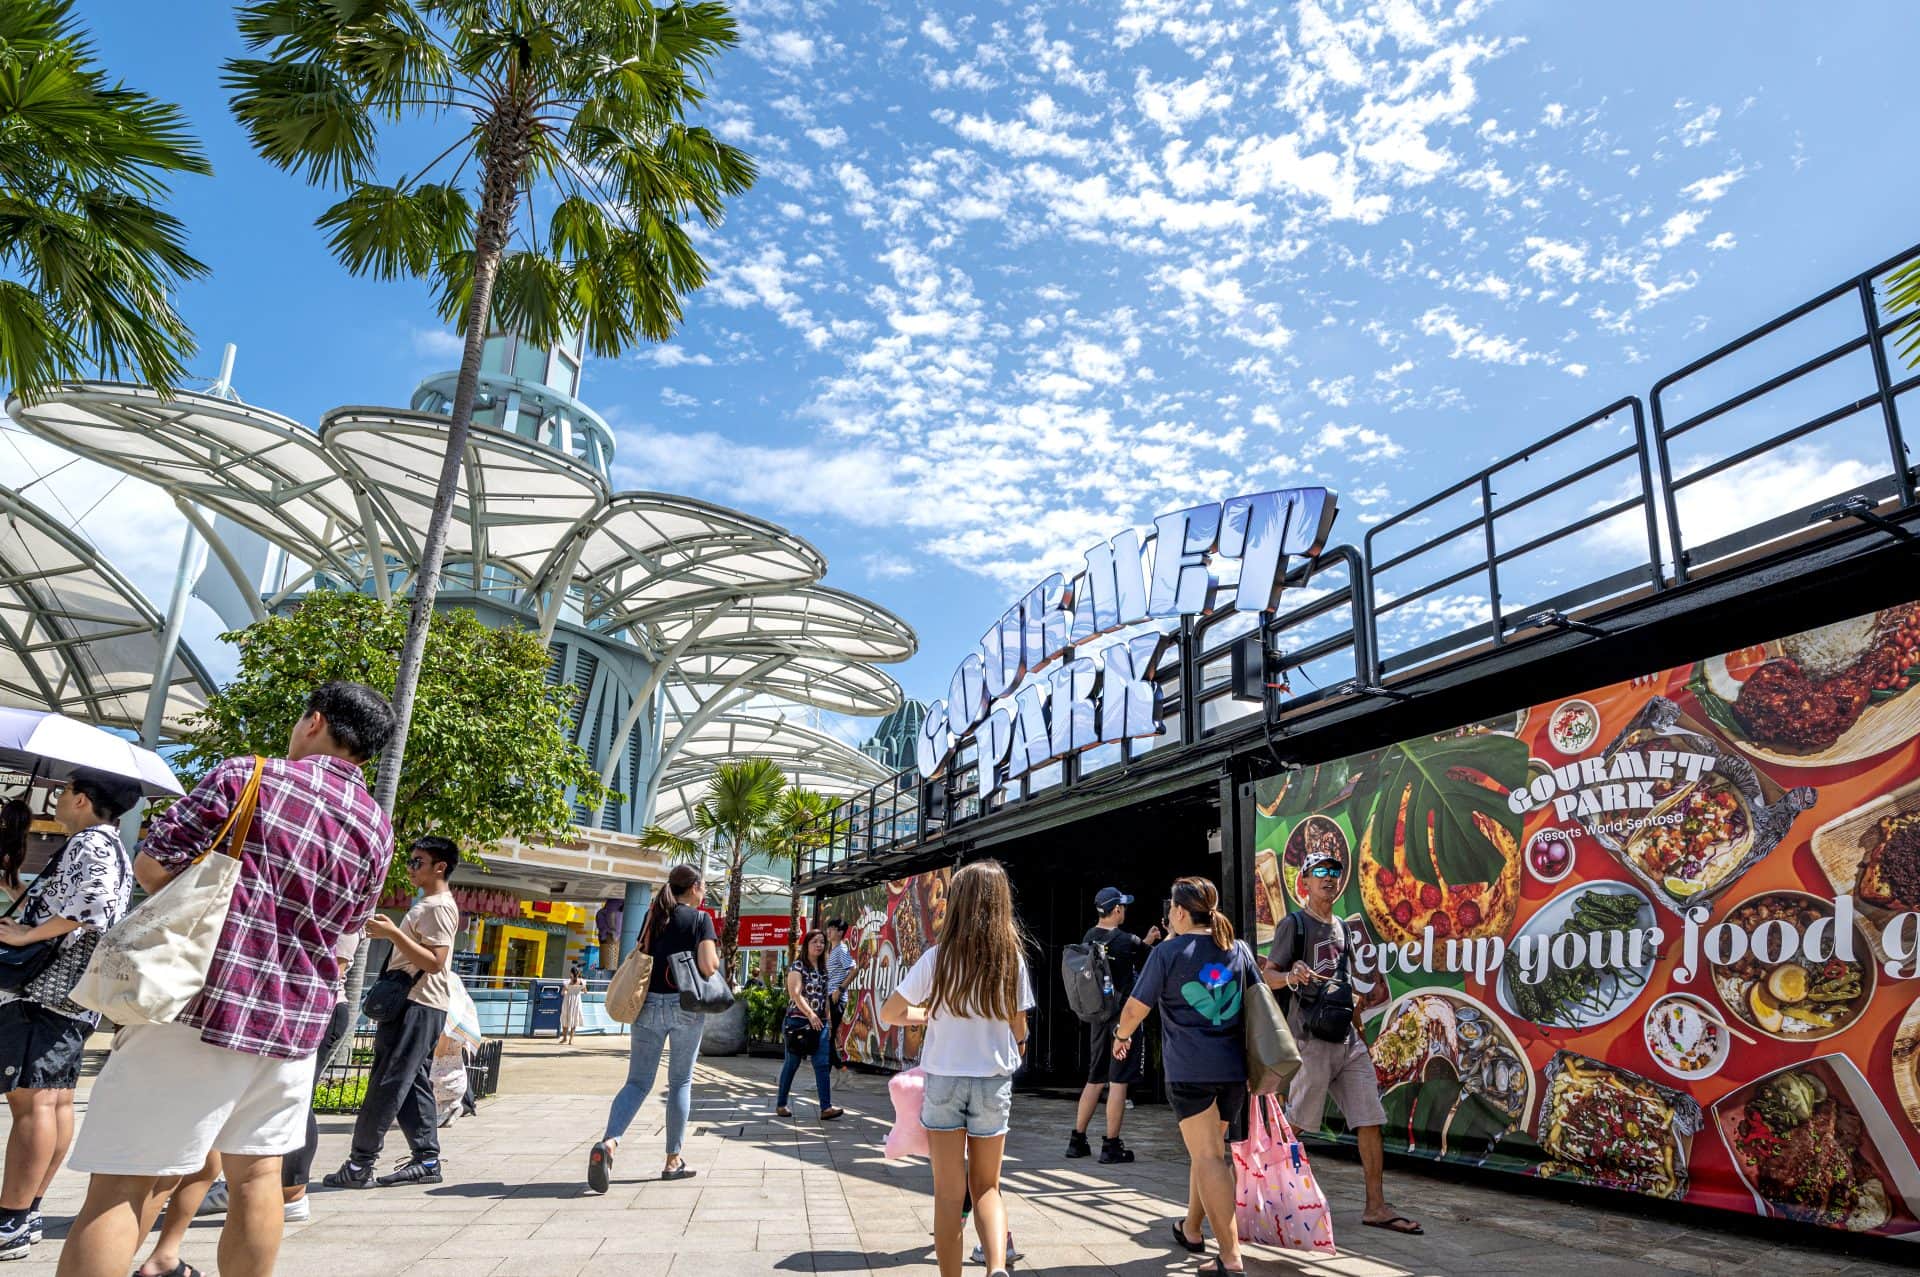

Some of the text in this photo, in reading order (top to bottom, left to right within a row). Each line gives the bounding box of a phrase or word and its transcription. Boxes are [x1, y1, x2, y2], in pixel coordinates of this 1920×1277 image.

[917, 486, 1338, 779] GOURMET
[976, 631, 1168, 800] PARK
[1508, 751, 1715, 814] GOURMET
[1552, 781, 1656, 823] PARK
[1537, 813, 1685, 842] Resorts World Sentosa
[1446, 935, 1505, 985] up
[1518, 927, 1664, 985] your
[1672, 894, 1857, 984] food
